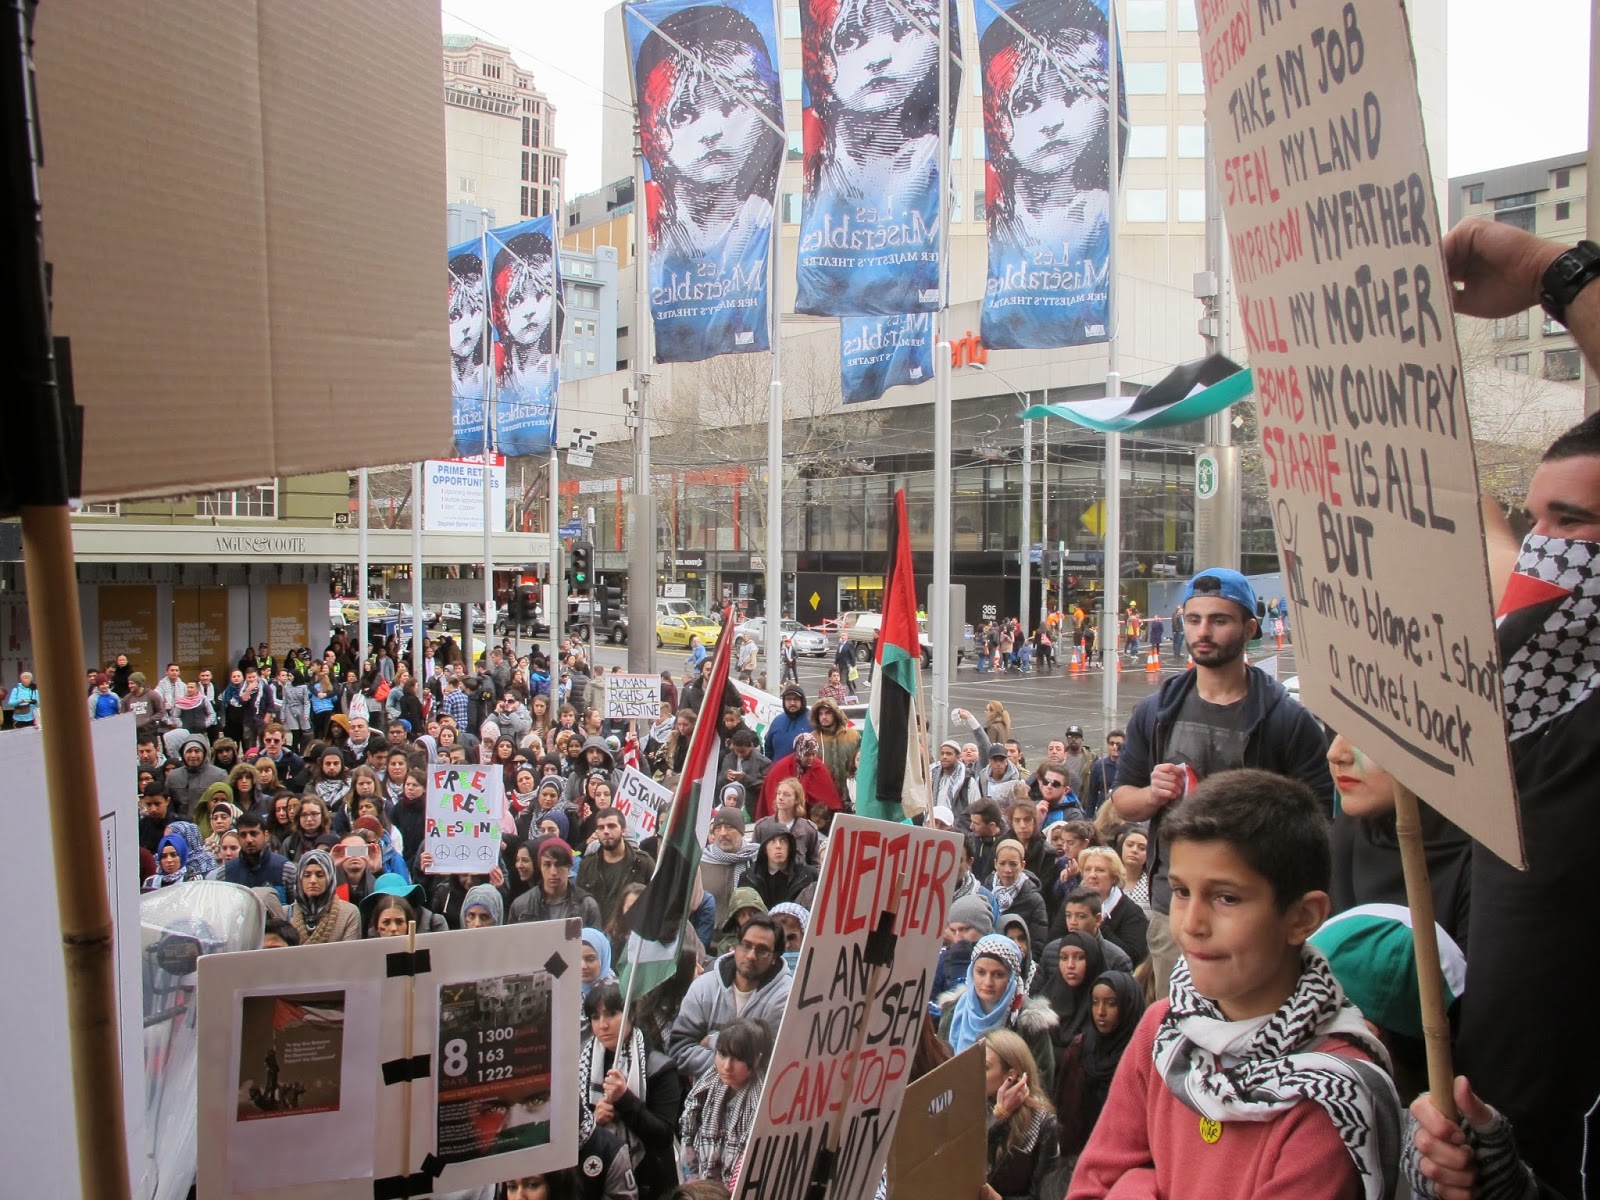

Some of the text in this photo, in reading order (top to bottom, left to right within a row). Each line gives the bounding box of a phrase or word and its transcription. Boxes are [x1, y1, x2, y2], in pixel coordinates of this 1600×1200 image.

[1229, 64, 1275, 143] TAKE
[1276, 45, 1310, 119] MY
[1311, 3, 1364, 94] JOB
[1224, 91, 1381, 206] STEAL MY LAND
[1229, 207, 1304, 284] IMPRISON
[1240, 264, 1442, 354] KILL MY MOTHER
[1257, 363, 1458, 440] BOMB MY COUNTRY
[462, 454, 497, 465] LEAE
[432, 475, 500, 489] OPPORTUNIES
[438, 465, 495, 478] PRIME RETL
[1263, 426, 1456, 534] STARVE US ALL
[1318, 502, 1374, 581] BUT
[982, 605, 997, 615] 385
[1312, 577, 1336, 624] am
[1339, 579, 1359, 629] to
[1431, 613, 1453, 683] I
[1452, 635, 1499, 714] shot
[610, 678, 648, 688] HUMAN
[610, 689, 657, 703] RIGHTS 4
[1328, 644, 1474, 766] a rocket back
[609, 702, 660, 717] PALESTINE
[434, 770, 486, 793] FREE,
[426, 818, 500, 839] PALESTINE
[815, 826, 956, 940] NEITHER
[805, 968, 925, 1059] NOR SEA
[477, 1027, 514, 1044] 1300
[443, 1038, 468, 1077] 8
[477, 1048, 504, 1064] 163
[477, 1065, 513, 1083] 1222
[1202, 1127, 1218, 1139] WAR
[1203, 1119, 1216, 1127] NO
